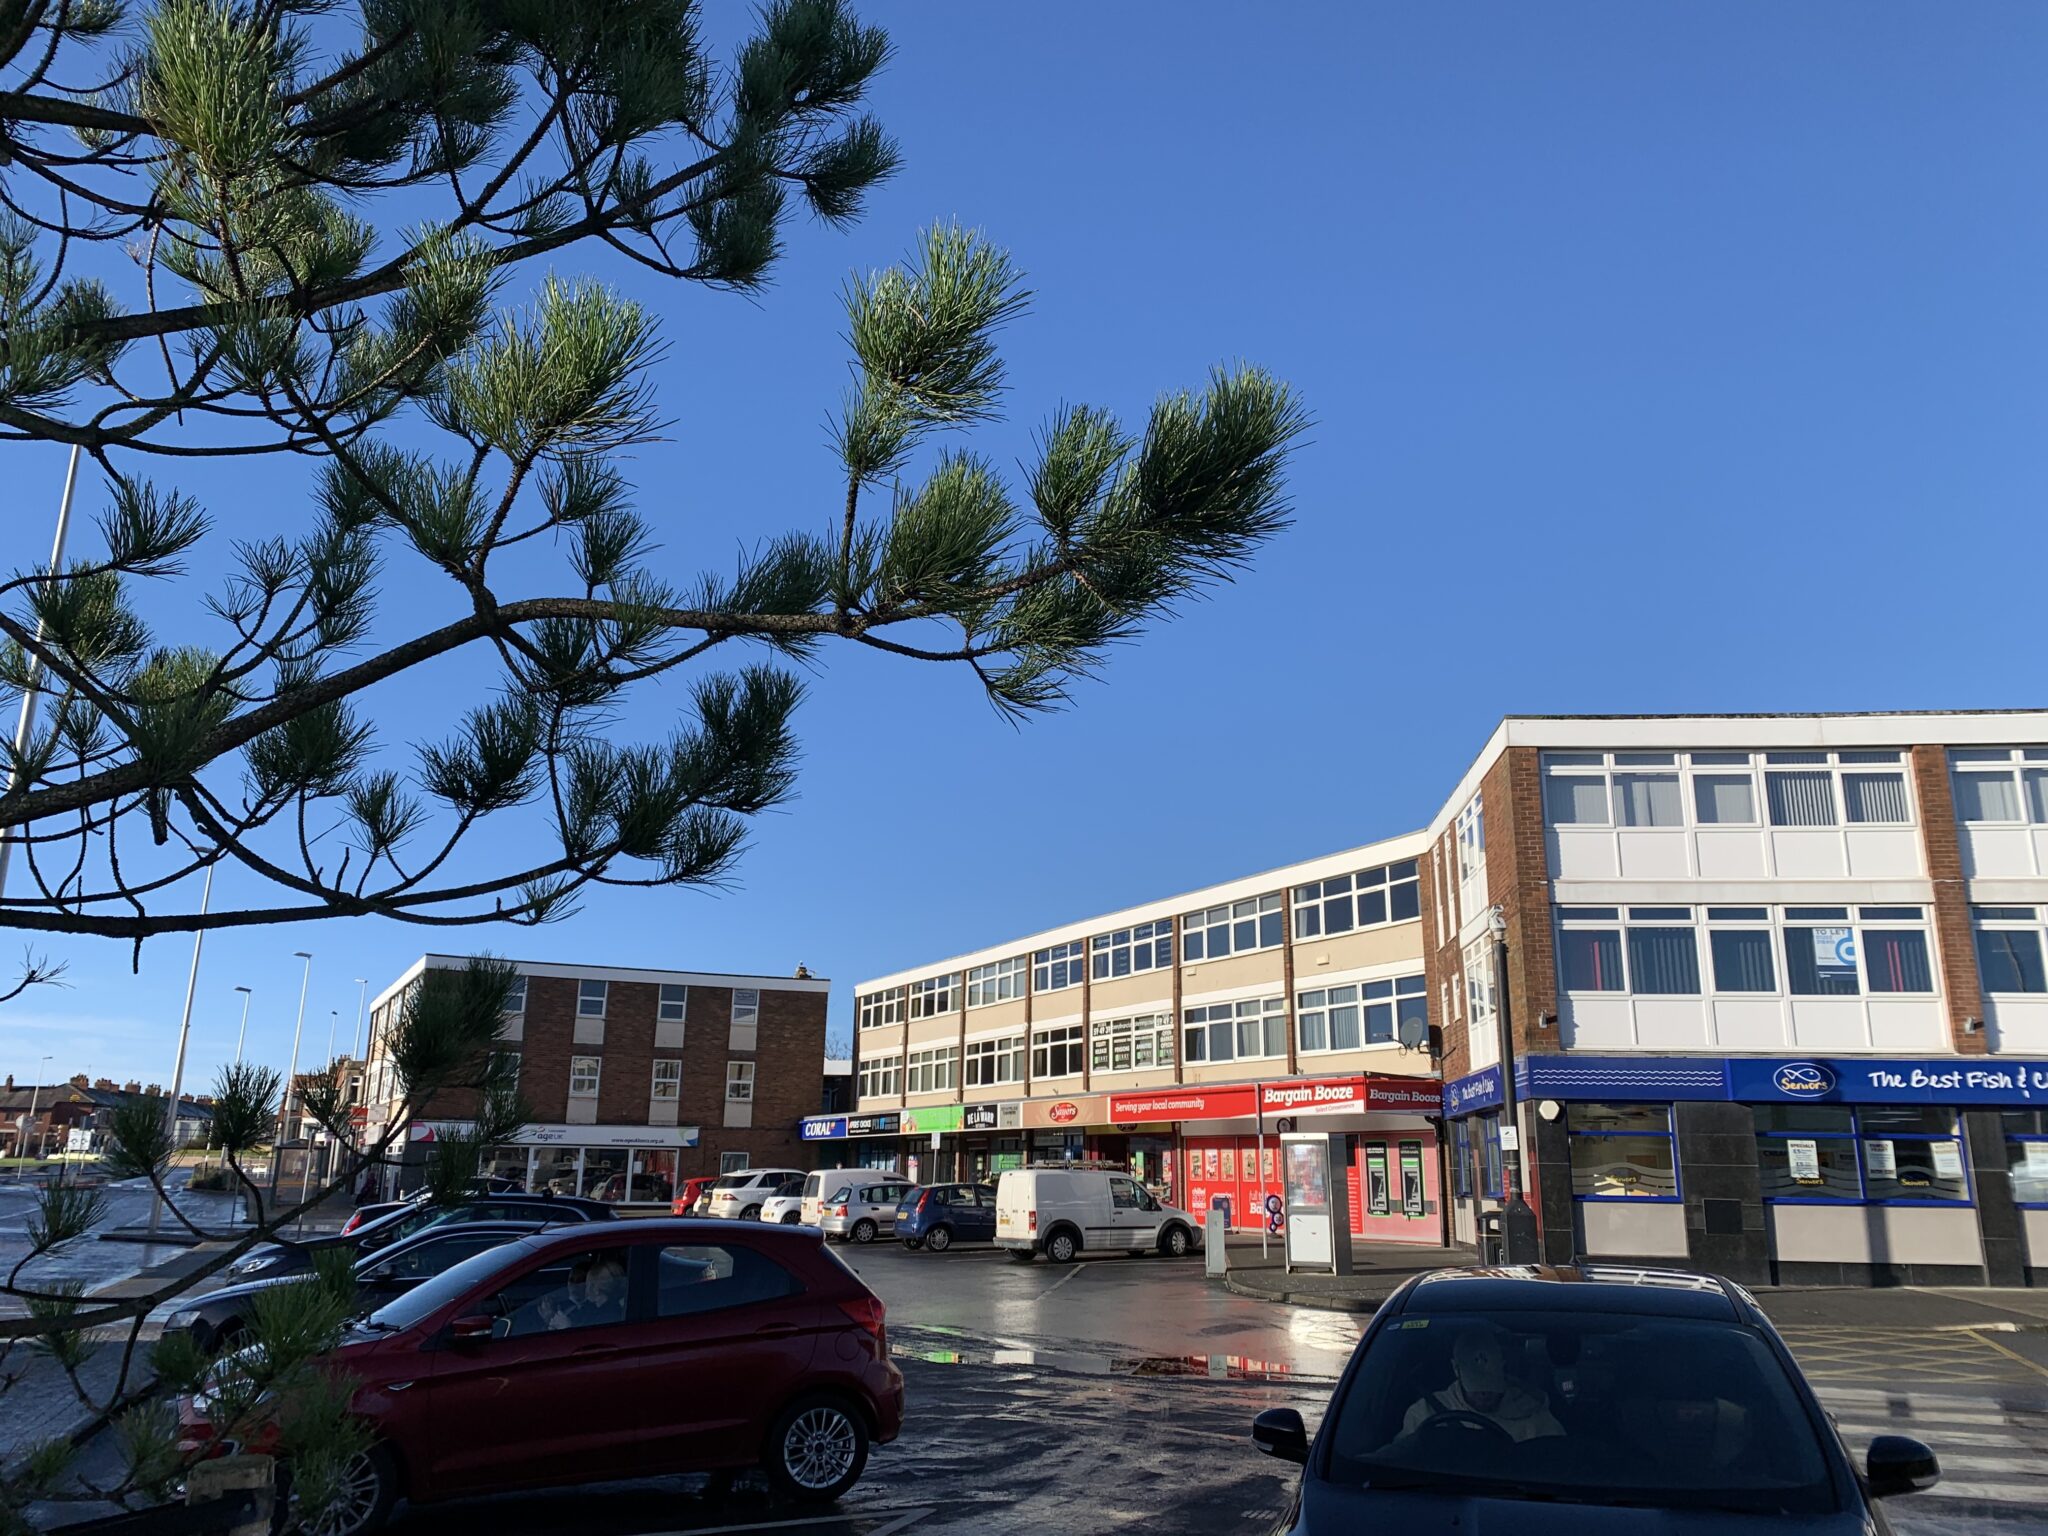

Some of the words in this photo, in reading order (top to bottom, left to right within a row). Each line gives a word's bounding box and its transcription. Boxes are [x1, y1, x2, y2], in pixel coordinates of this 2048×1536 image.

[1781, 1077, 1828, 1091] Seniors
[1868, 1070, 1906, 1088] The
[1910, 1069, 1963, 1089] Best
[1966, 1071, 2013, 1089] Fish
[2017, 1066, 2030, 1099] &
[1264, 1085, 1312, 1106] Bargain
[1314, 1085, 1353, 1101] Booze
[1369, 1089, 1410, 1103] Bargain
[1411, 1092, 1441, 1103] Booze
[1052, 1102, 1076, 1119] Sayers
[1115, 1101, 1137, 1113] Serving
[1138, 1103, 1151, 1113] your
[1152, 1100, 1167, 1110] local
[1168, 1097, 1204, 1110] community
[805, 1121, 831, 1136] CORAL
